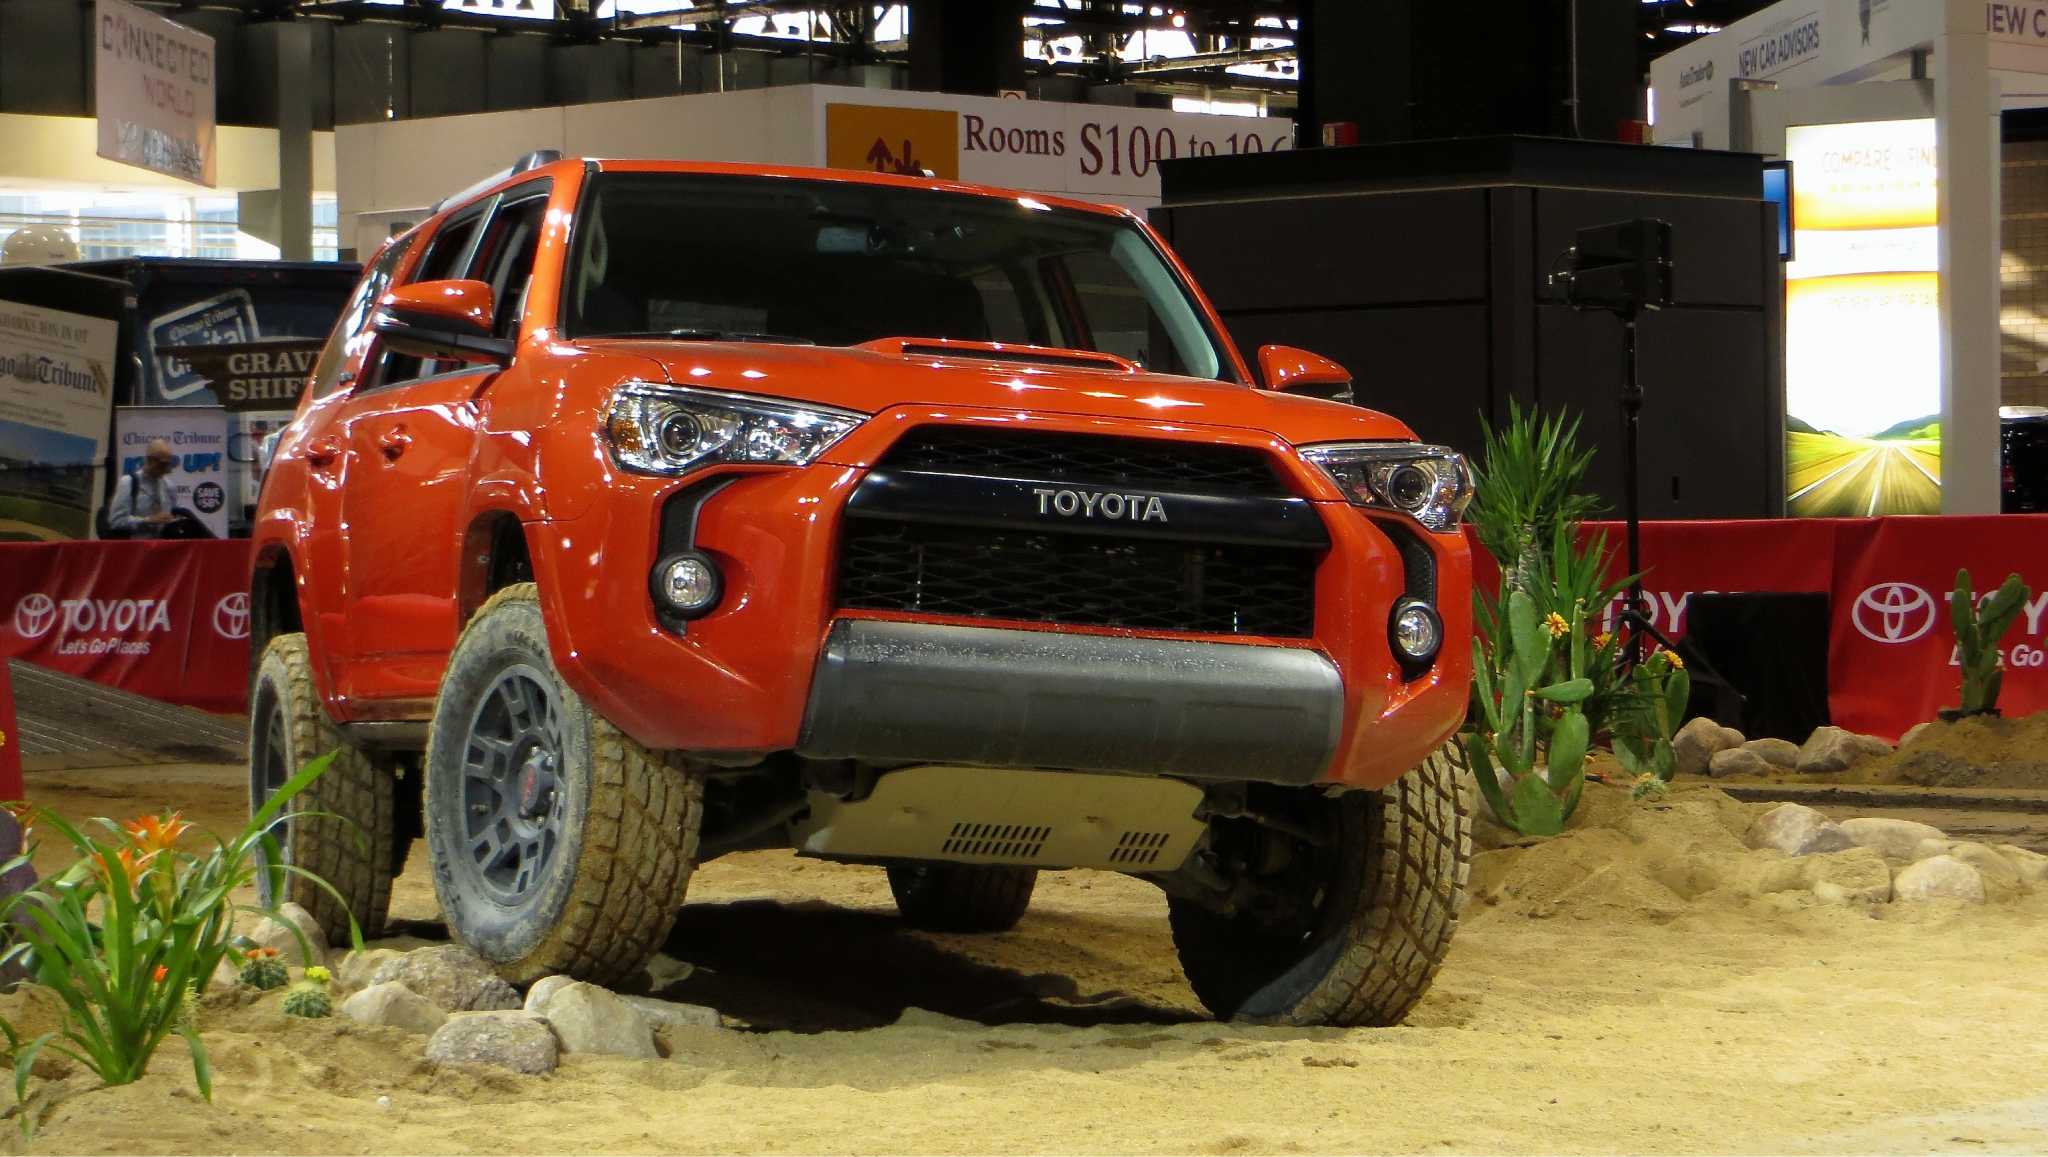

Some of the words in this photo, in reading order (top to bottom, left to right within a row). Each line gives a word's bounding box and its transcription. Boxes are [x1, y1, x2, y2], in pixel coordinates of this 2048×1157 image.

[1738, 46, 1758, 78] NEW
[1760, 39, 1777, 70] CAR
[1777, 21, 1819, 64] ADVISORS
[963, 114, 1065, 157] Rooms
[1079, 122, 1177, 178] S100
[228, 352, 318, 375] GRAV
[229, 377, 307, 400] SHIF
[173, 431, 222, 445] Tribune
[1033, 488, 1168, 522] TOYOTA
[60, 598, 171, 632] TOYOTA
[59, 638, 89, 654] Let's
[89, 638, 107, 654] Go
[106, 637, 151, 655] Places
[2010, 644, 2044, 667] Go
